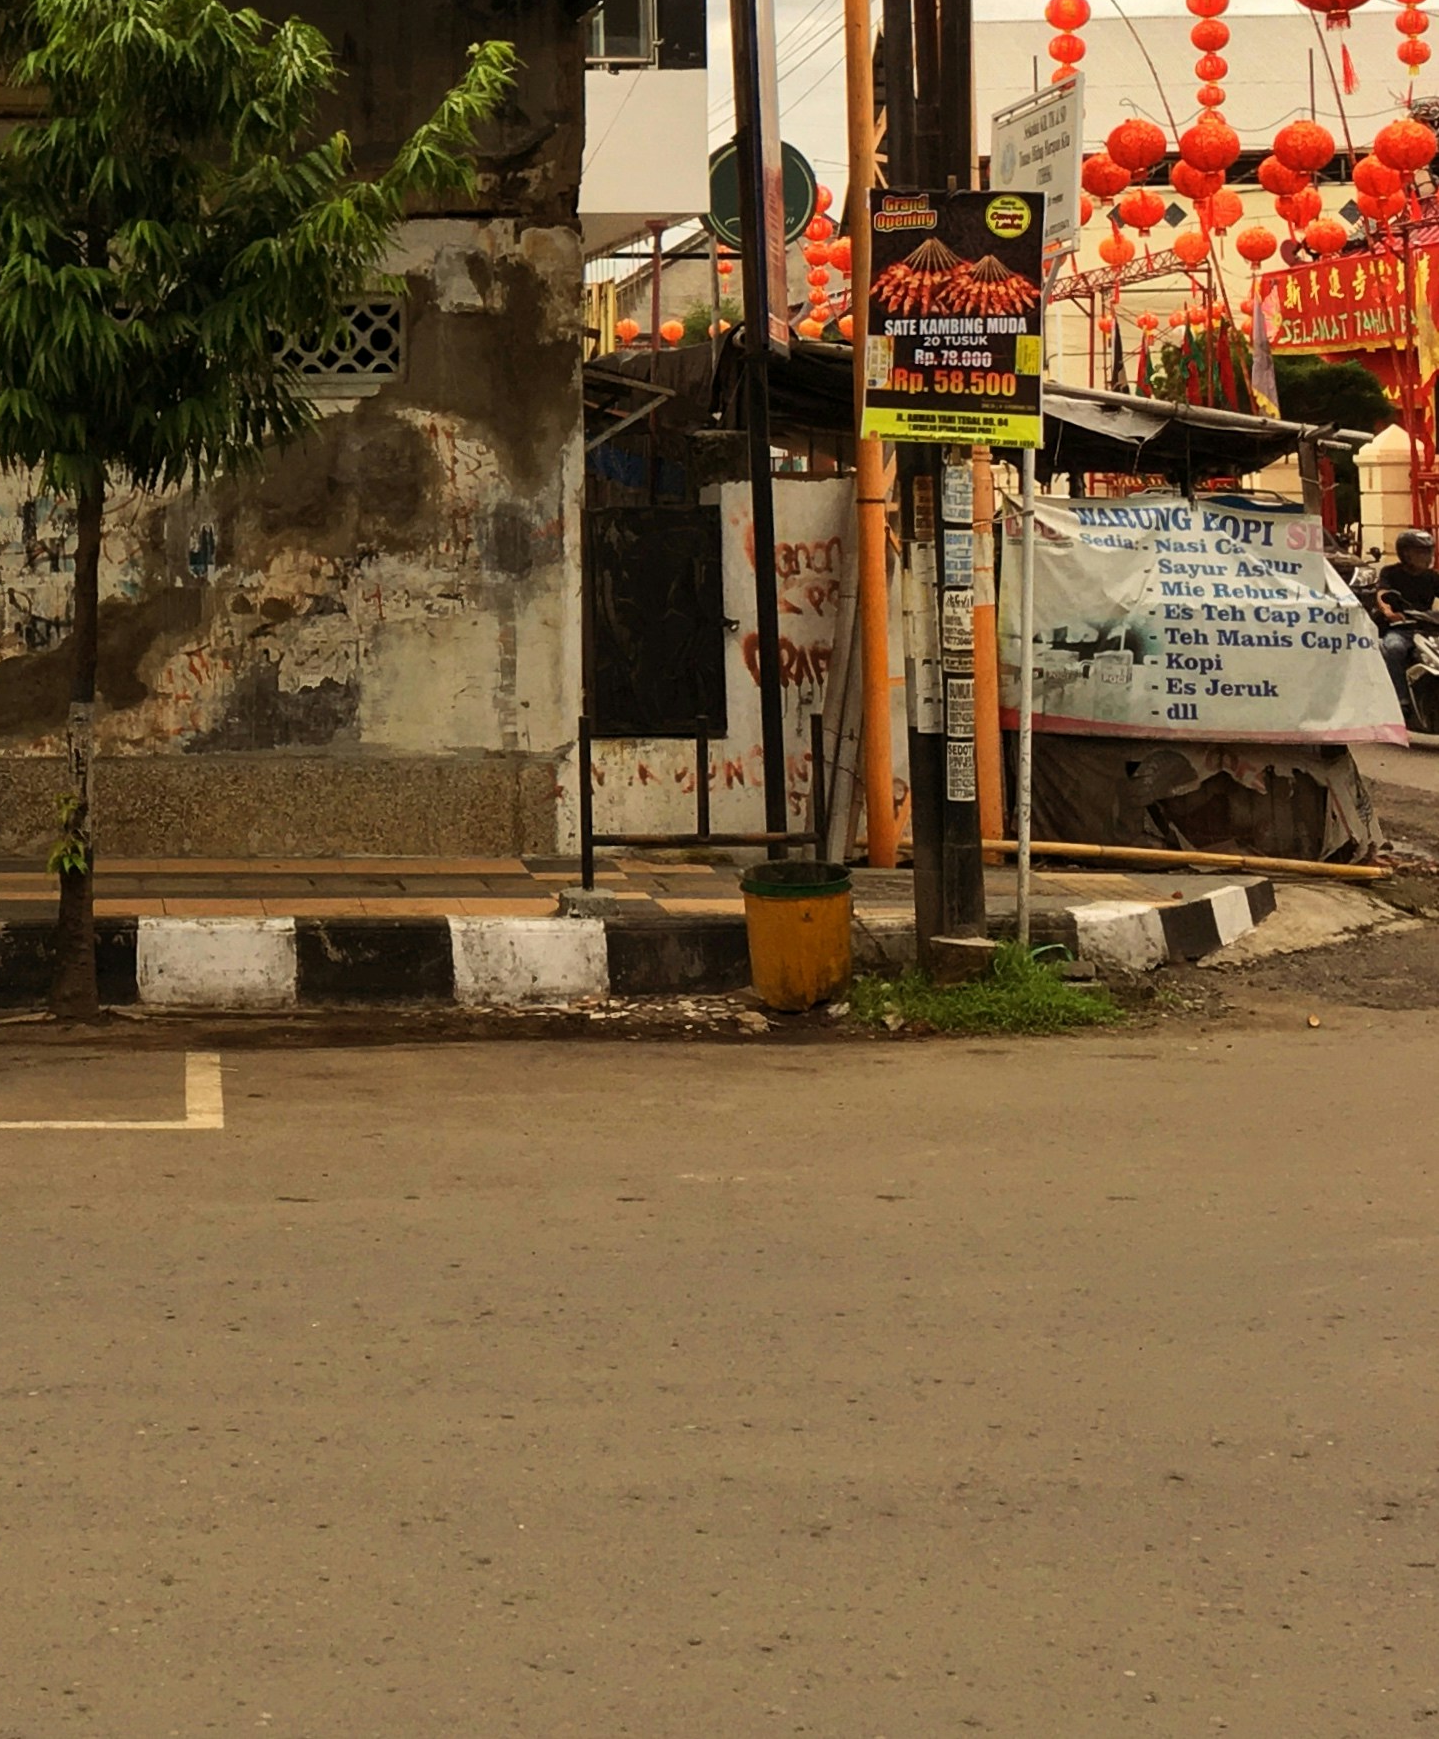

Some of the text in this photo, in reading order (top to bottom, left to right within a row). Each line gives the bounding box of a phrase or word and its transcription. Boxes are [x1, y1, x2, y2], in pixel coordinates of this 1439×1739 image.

[884, 195, 928, 212] Grand
[875, 212, 936, 230] Opening
[884, 317, 1027, 336] SATE KAMBING MUDA
[1277, 313, 1348, 345] SELAMAT
[923, 336, 988, 346] 20 TUSUK
[914, 349, 992, 368] Rp. 78.000
[894, 367, 1016, 397] Rp. 58.500
[1070, 507, 1192, 532] WARUNG
[1202, 513, 1274, 546] KOPI
[1079, 533, 1139, 550] Sedia:
[1155, 539, 1205, 554] Nasi
[1159, 559, 1228, 578] Sayur
[1161, 582, 1205, 597] Mie
[1213, 583, 1288, 600] Rebus
[1164, 604, 1350, 627] Es Teh Cap Poci
[1165, 628, 1209, 646] Teh
[1217, 630, 1293, 648] Manis
[1301, 631, 1342, 653] Cap
[1166, 653, 1223, 674] Kopi
[1166, 679, 1279, 697] Es Jeruk
[1167, 703, 1198, 720] dll
